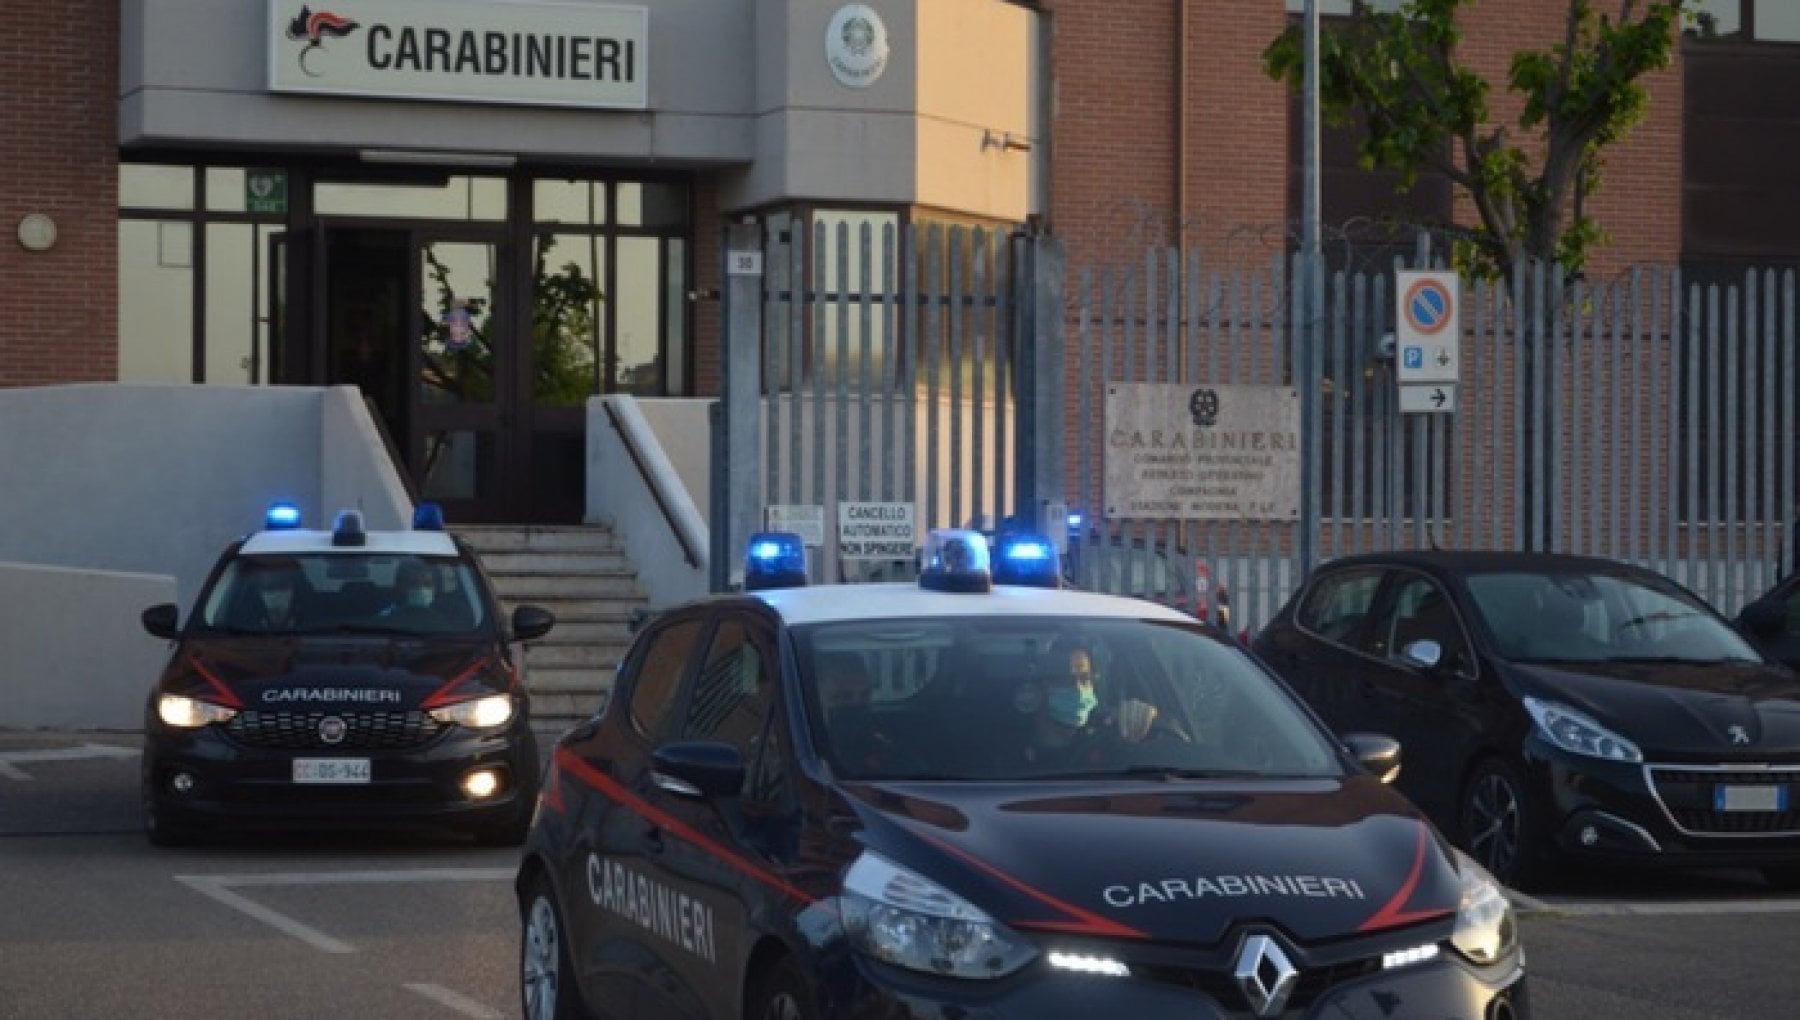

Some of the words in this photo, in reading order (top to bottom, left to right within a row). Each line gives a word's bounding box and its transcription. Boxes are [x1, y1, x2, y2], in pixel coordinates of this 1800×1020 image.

[366, 23, 635, 83] CARABINIERI
[1408, 348, 1419, 366] P
[1110, 429, 1296, 450] CARABINIERI
[848, 506, 906, 520] CANCELLO
[843, 523, 911, 537] AUTOMATICO
[840, 542, 861, 554] NON
[864, 542, 913, 555] SPINGERE
[262, 688, 402, 703] CARABINIERI
[1102, 874, 1366, 908] CARABINIERI
[586, 852, 716, 964] CARABINIERI
